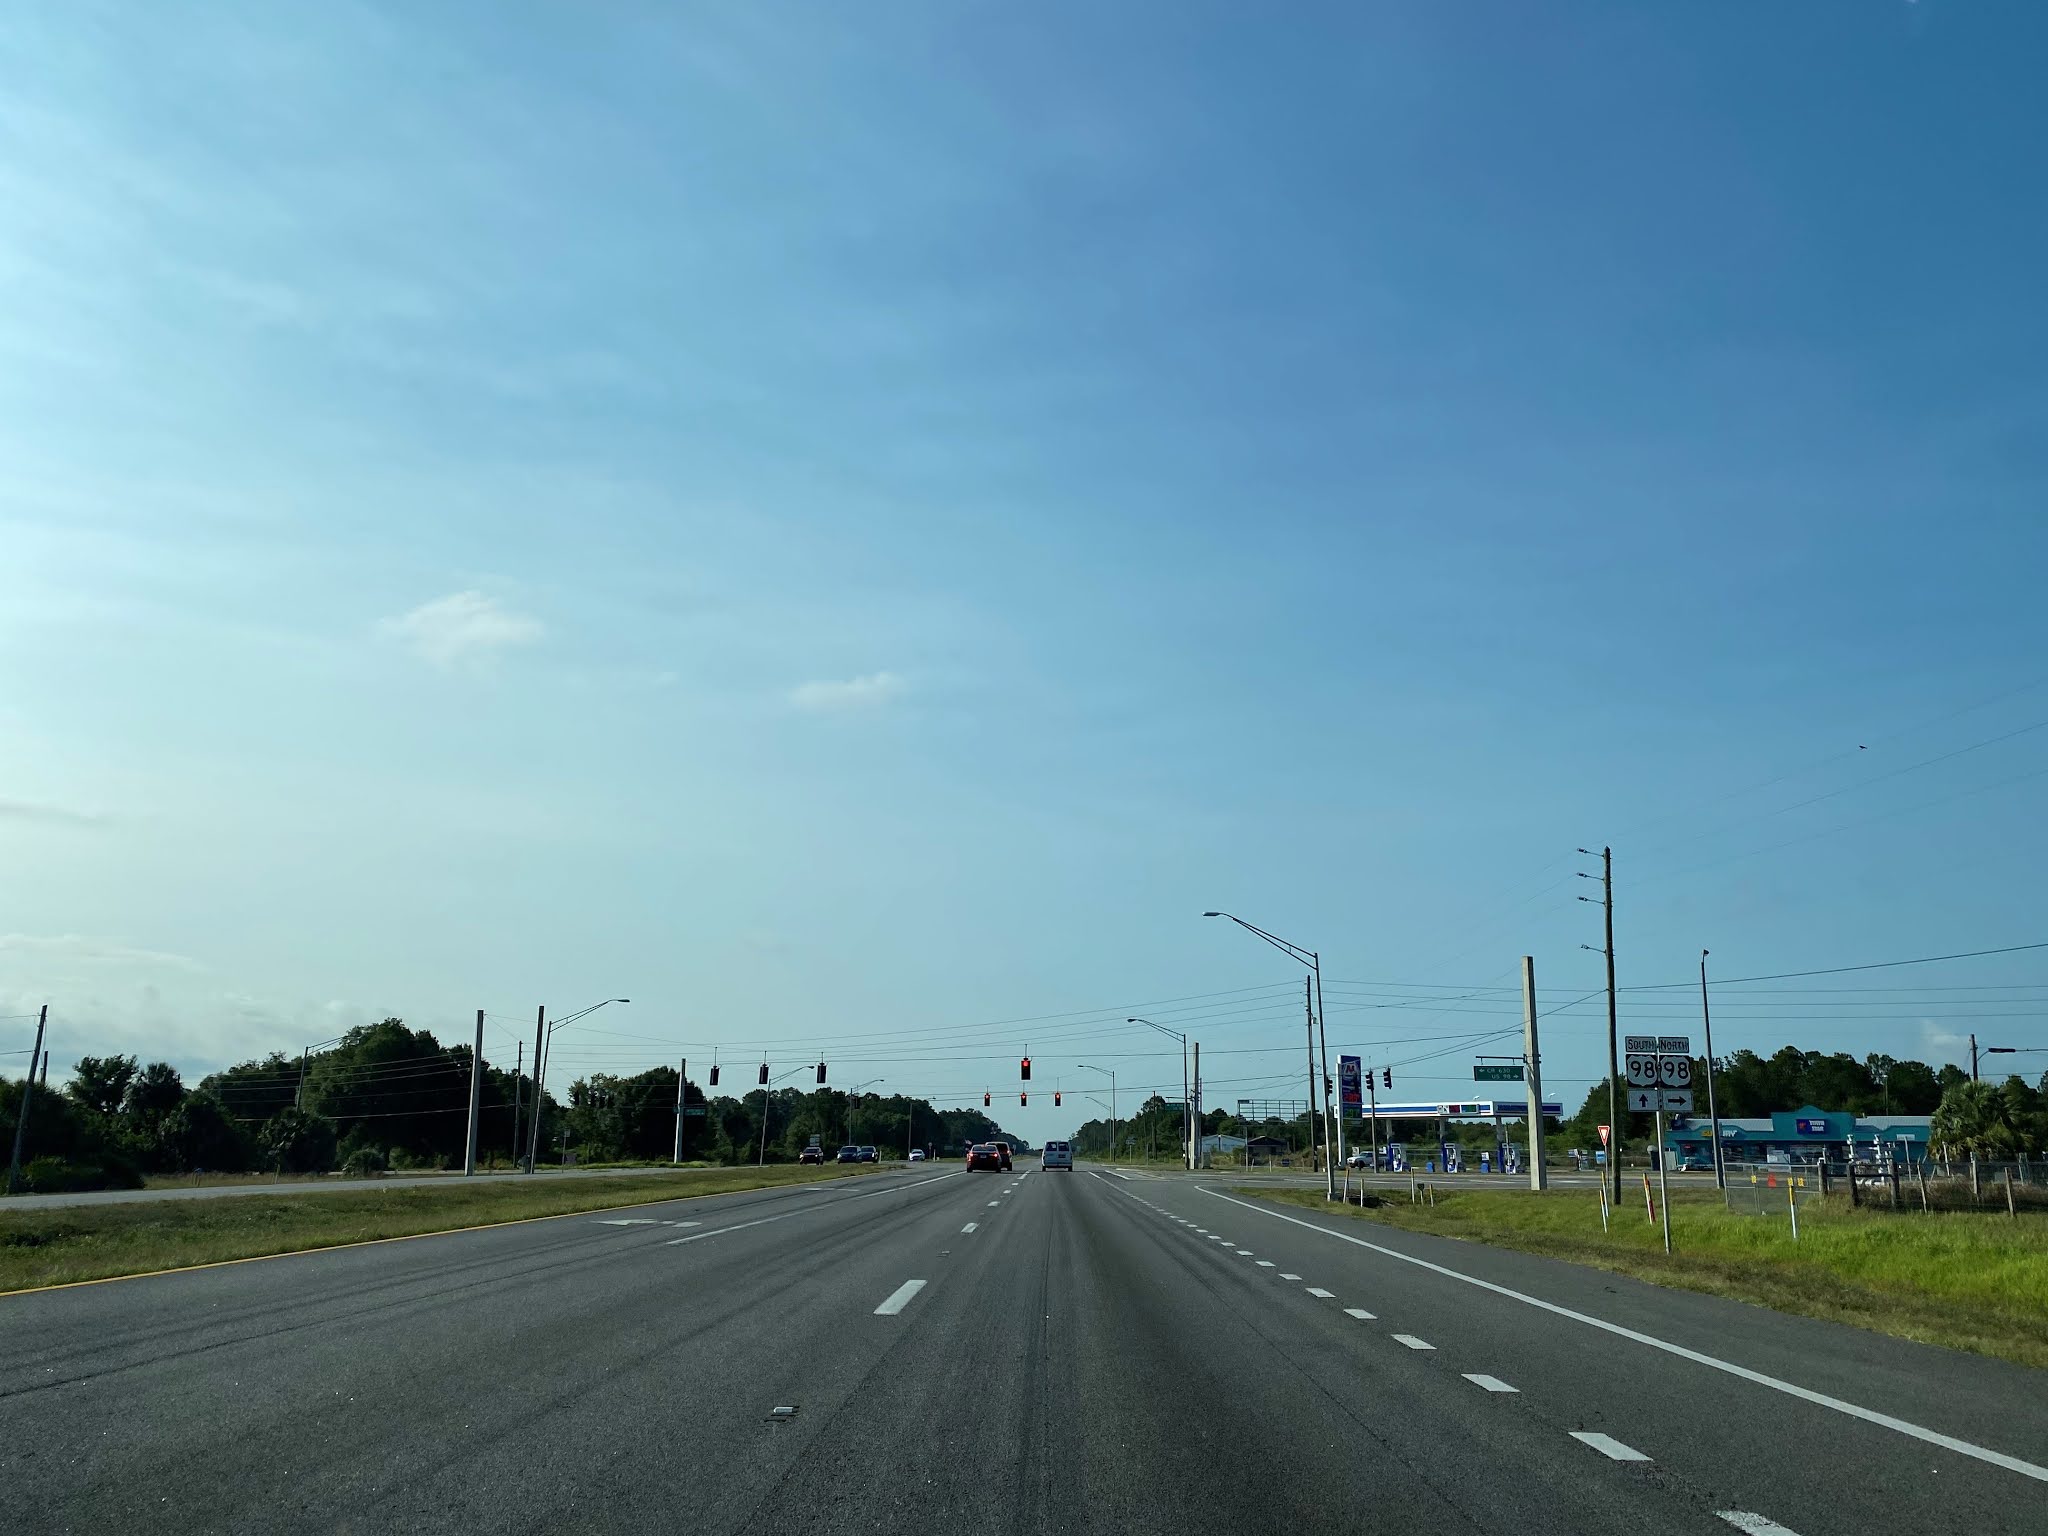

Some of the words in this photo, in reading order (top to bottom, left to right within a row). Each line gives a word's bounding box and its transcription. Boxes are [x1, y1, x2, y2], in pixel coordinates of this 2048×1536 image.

[1627, 1039, 1655, 1050] SOUTH
[1660, 1040, 1688, 1051] NORTH
[1630, 1060, 1656, 1079] 98
[1663, 1061, 1689, 1080] 98
